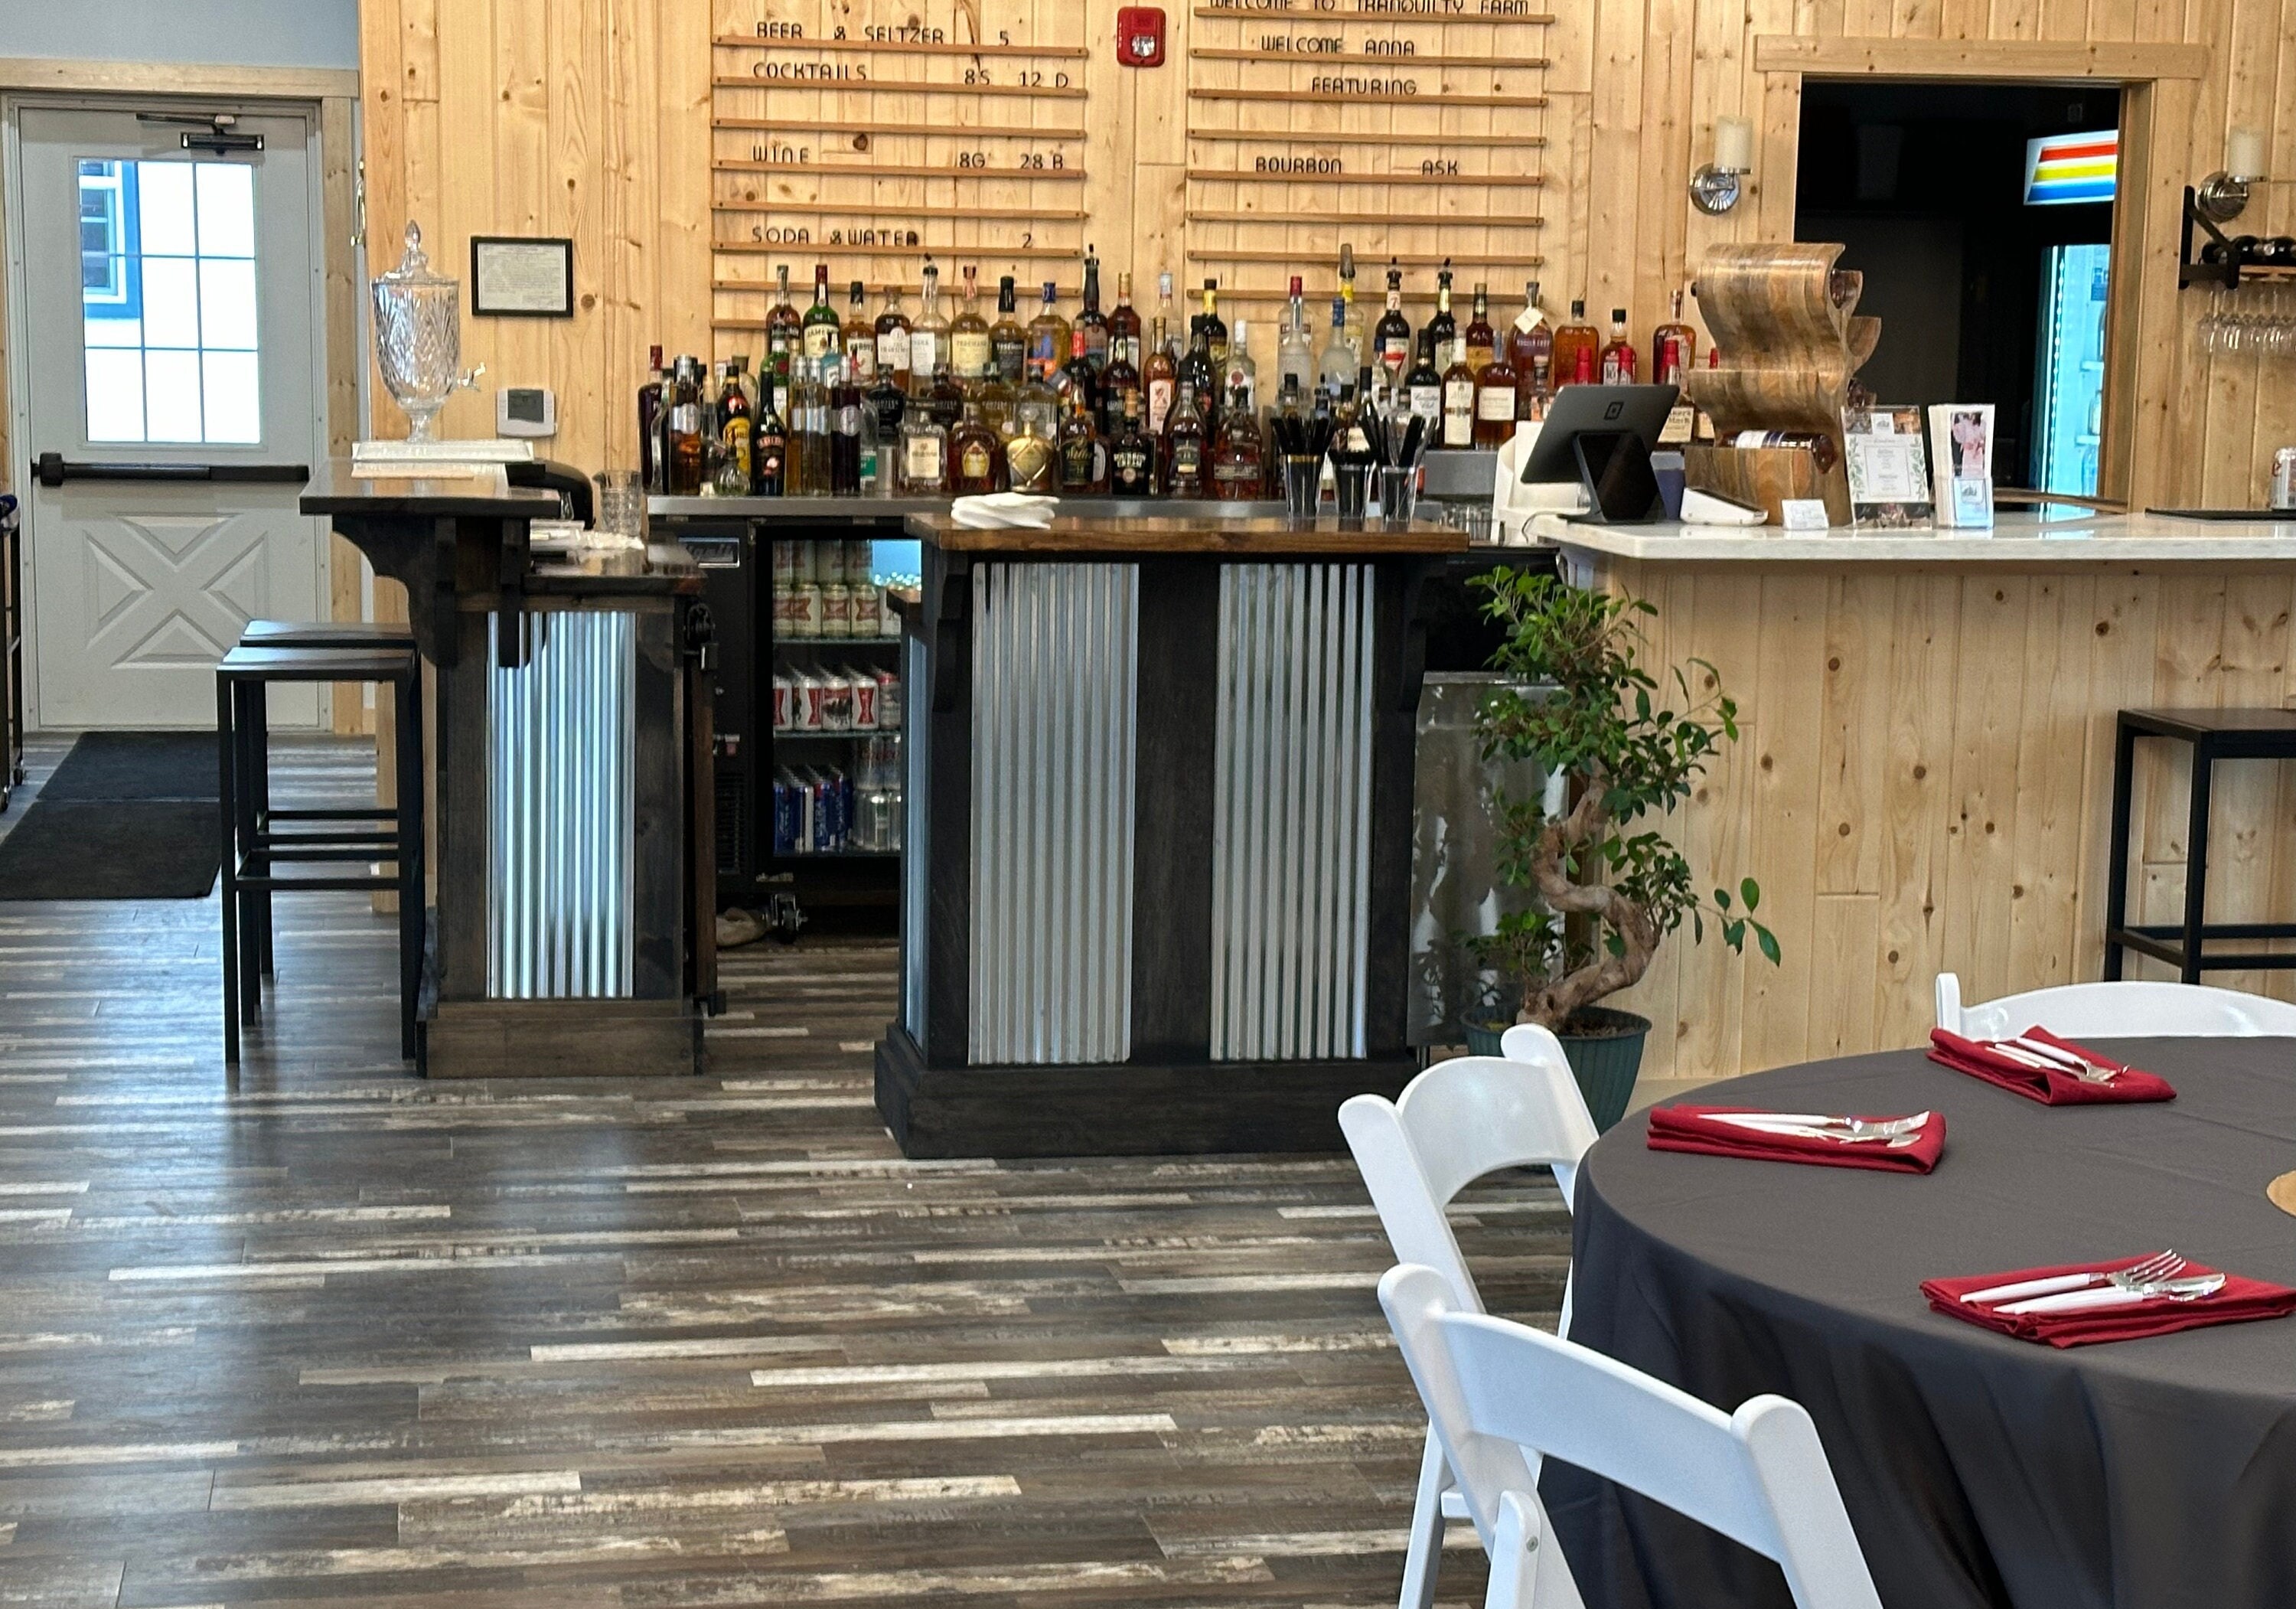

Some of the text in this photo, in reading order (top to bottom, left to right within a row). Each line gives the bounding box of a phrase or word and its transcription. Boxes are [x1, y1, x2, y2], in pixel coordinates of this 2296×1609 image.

[1313, 0, 1335, 11] TO
[1480, 0, 1528, 15] FARM
[757, 21, 1009, 46] BEER & SELTZER 5
[1261, 35, 1415, 56] WELCOME ANNA
[753, 63, 867, 80] COCKTAILS
[1019, 70, 1041, 86] 12
[1055, 72, 1068, 88] D
[1312, 77, 1417, 95] FEATURING
[753, 145, 809, 164] WINE
[1021, 154, 1043, 169] 28
[1053, 155, 1063, 170] B
[1255, 156, 1458, 176] BOURBON ASK
[752, 227, 809, 244] SODA
[1022, 233, 1032, 249] 2
